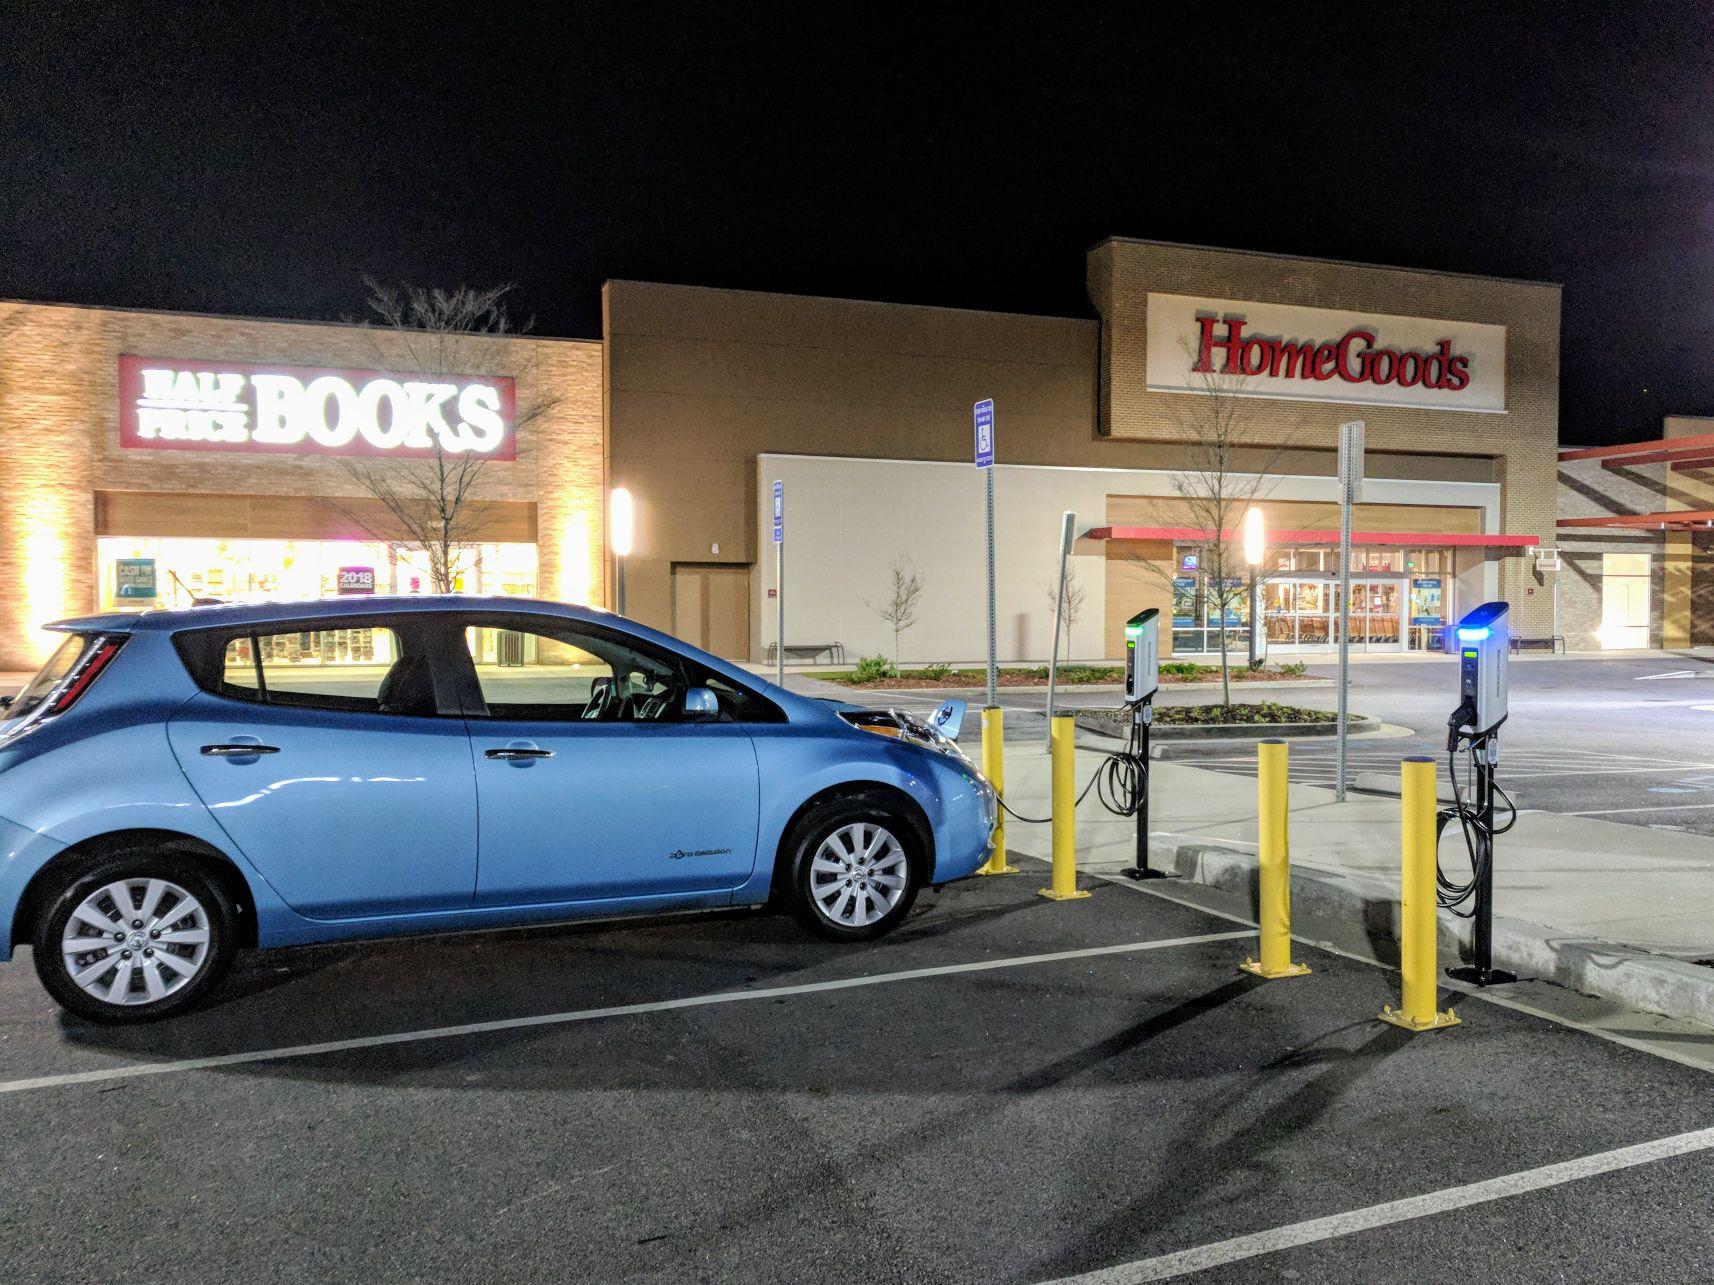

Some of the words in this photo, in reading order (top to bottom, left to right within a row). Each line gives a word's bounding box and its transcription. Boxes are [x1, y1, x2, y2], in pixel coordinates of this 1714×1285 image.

[1192, 317, 1471, 391] HomeGoods
[136, 408, 248, 442] PRICE
[251, 375, 504, 452] BOOKS
[340, 572, 373, 583] 2018
